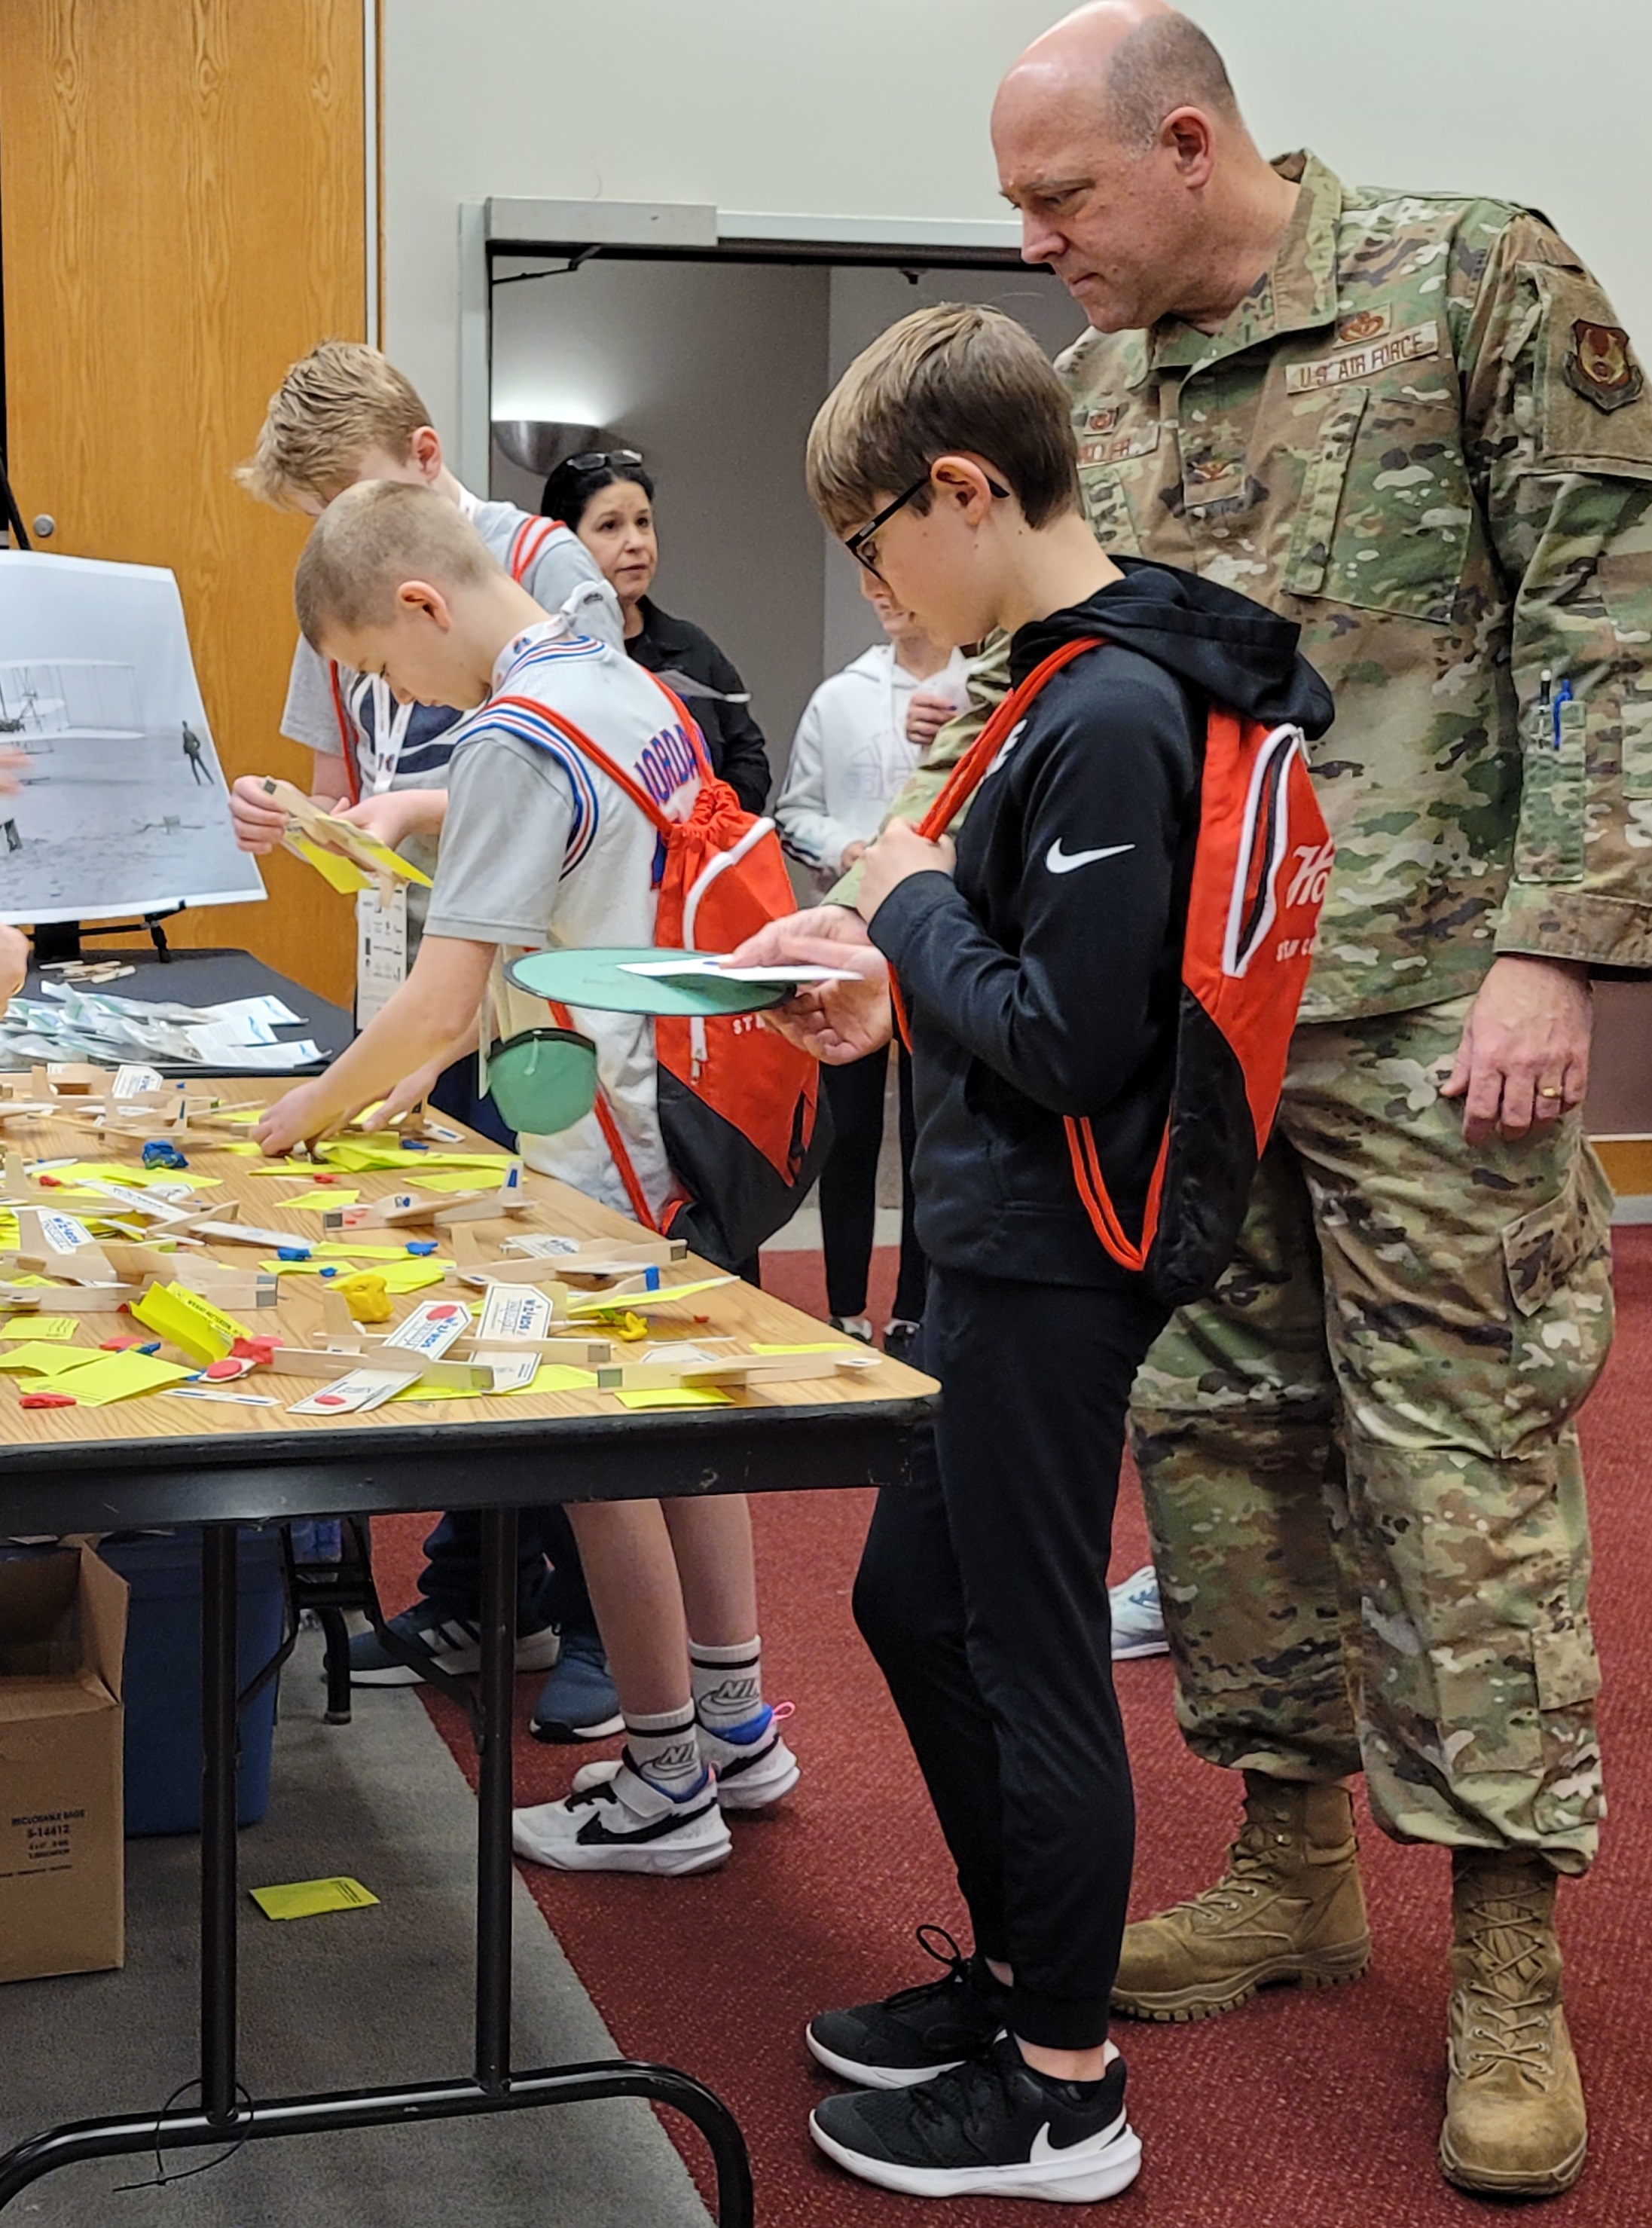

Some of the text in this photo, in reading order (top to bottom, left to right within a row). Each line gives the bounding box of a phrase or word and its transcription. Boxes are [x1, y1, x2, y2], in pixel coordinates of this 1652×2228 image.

[1339, 353, 1366, 380] AIR
[1371, 332, 1423, 369] FORCE
[634, 724, 713, 806] JORDA
